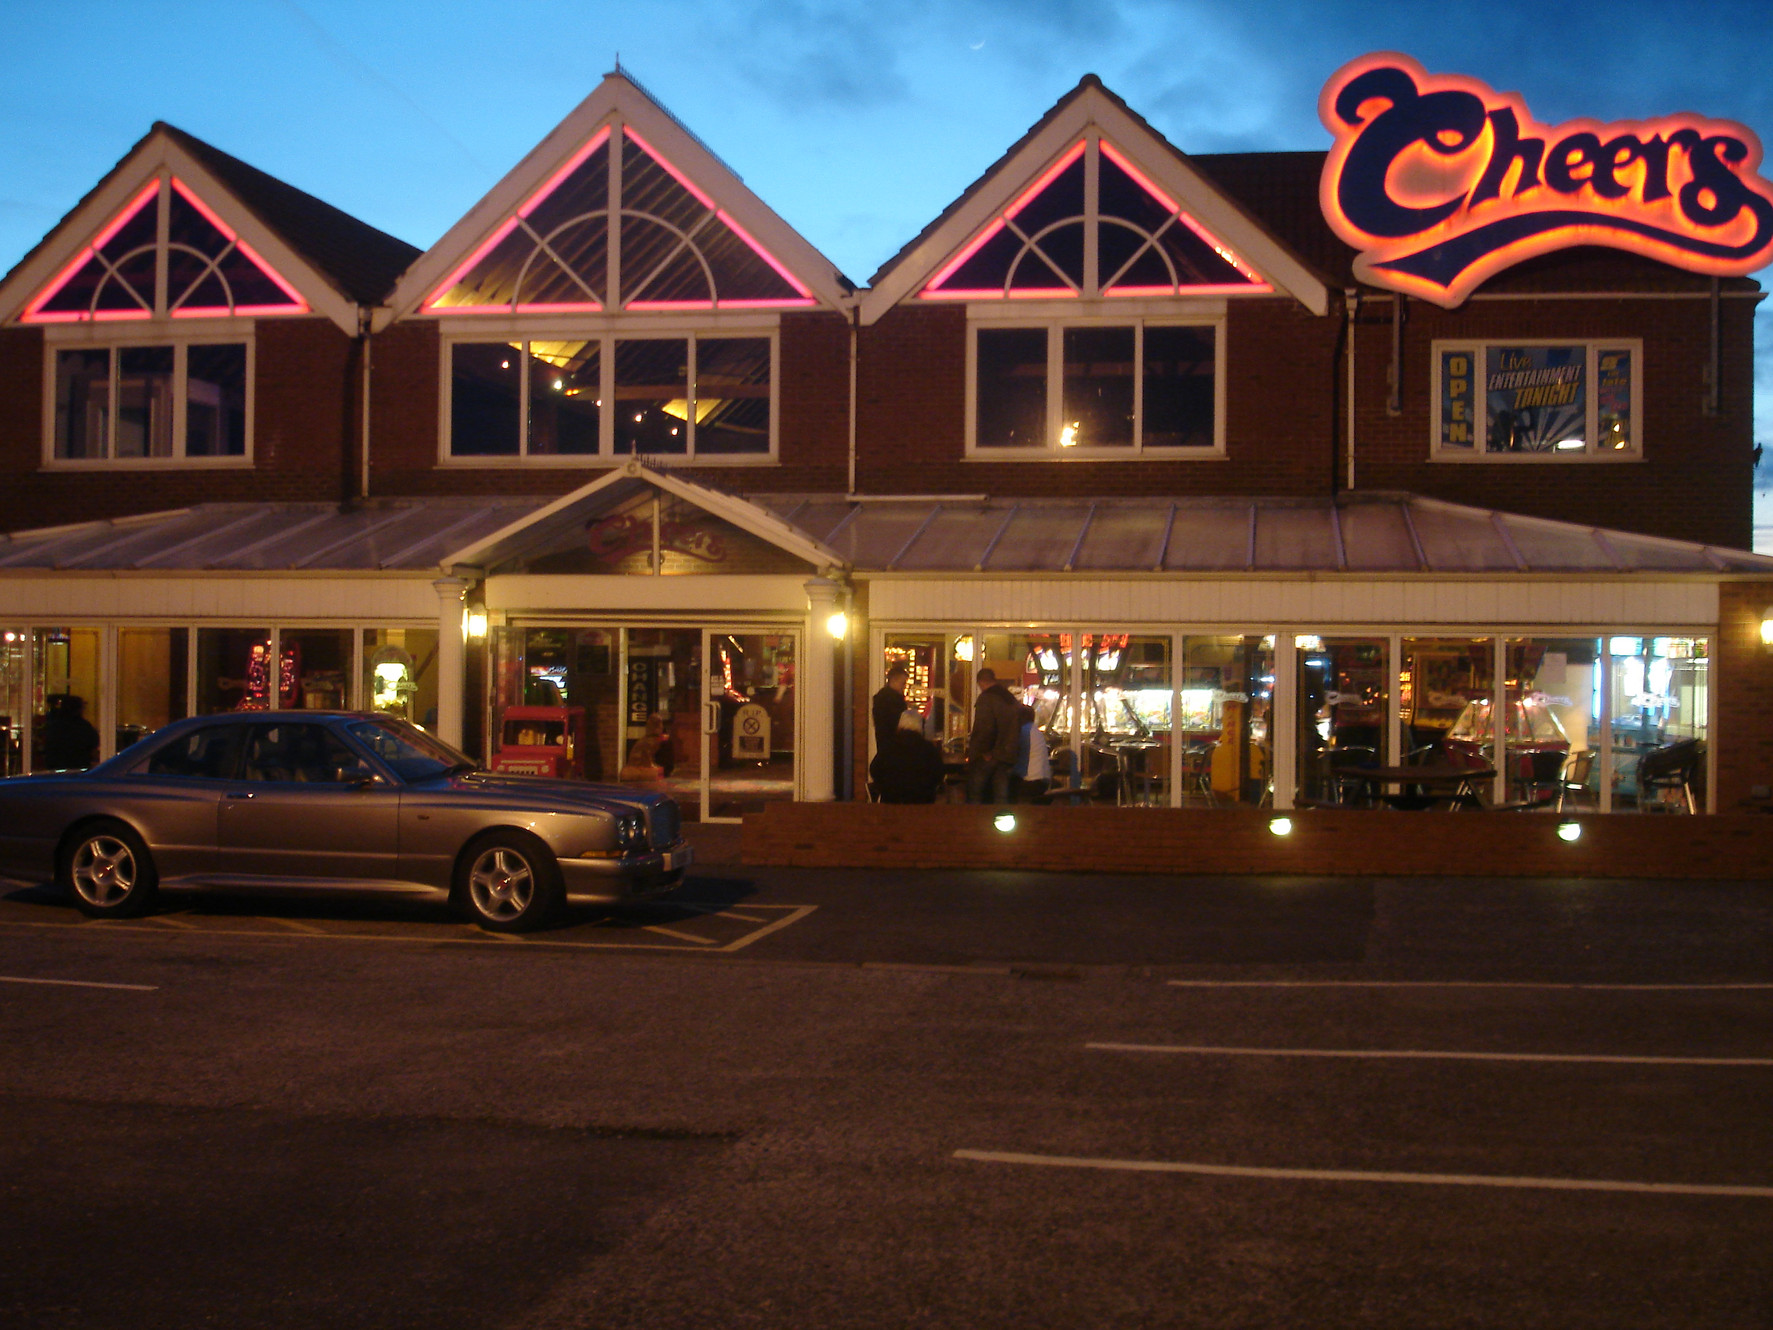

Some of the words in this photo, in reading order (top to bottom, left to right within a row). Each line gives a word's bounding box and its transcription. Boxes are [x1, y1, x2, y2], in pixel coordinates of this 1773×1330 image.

[1335, 66, 1773, 287] Cheers
[1487, 364, 1583, 392] ENTERTAINMENT
[1499, 351, 1533, 371] Live
[1449, 356, 1468, 443] OPEN
[1513, 381, 1580, 410] TONIGHT
[631, 661, 648, 722] CHANGE
